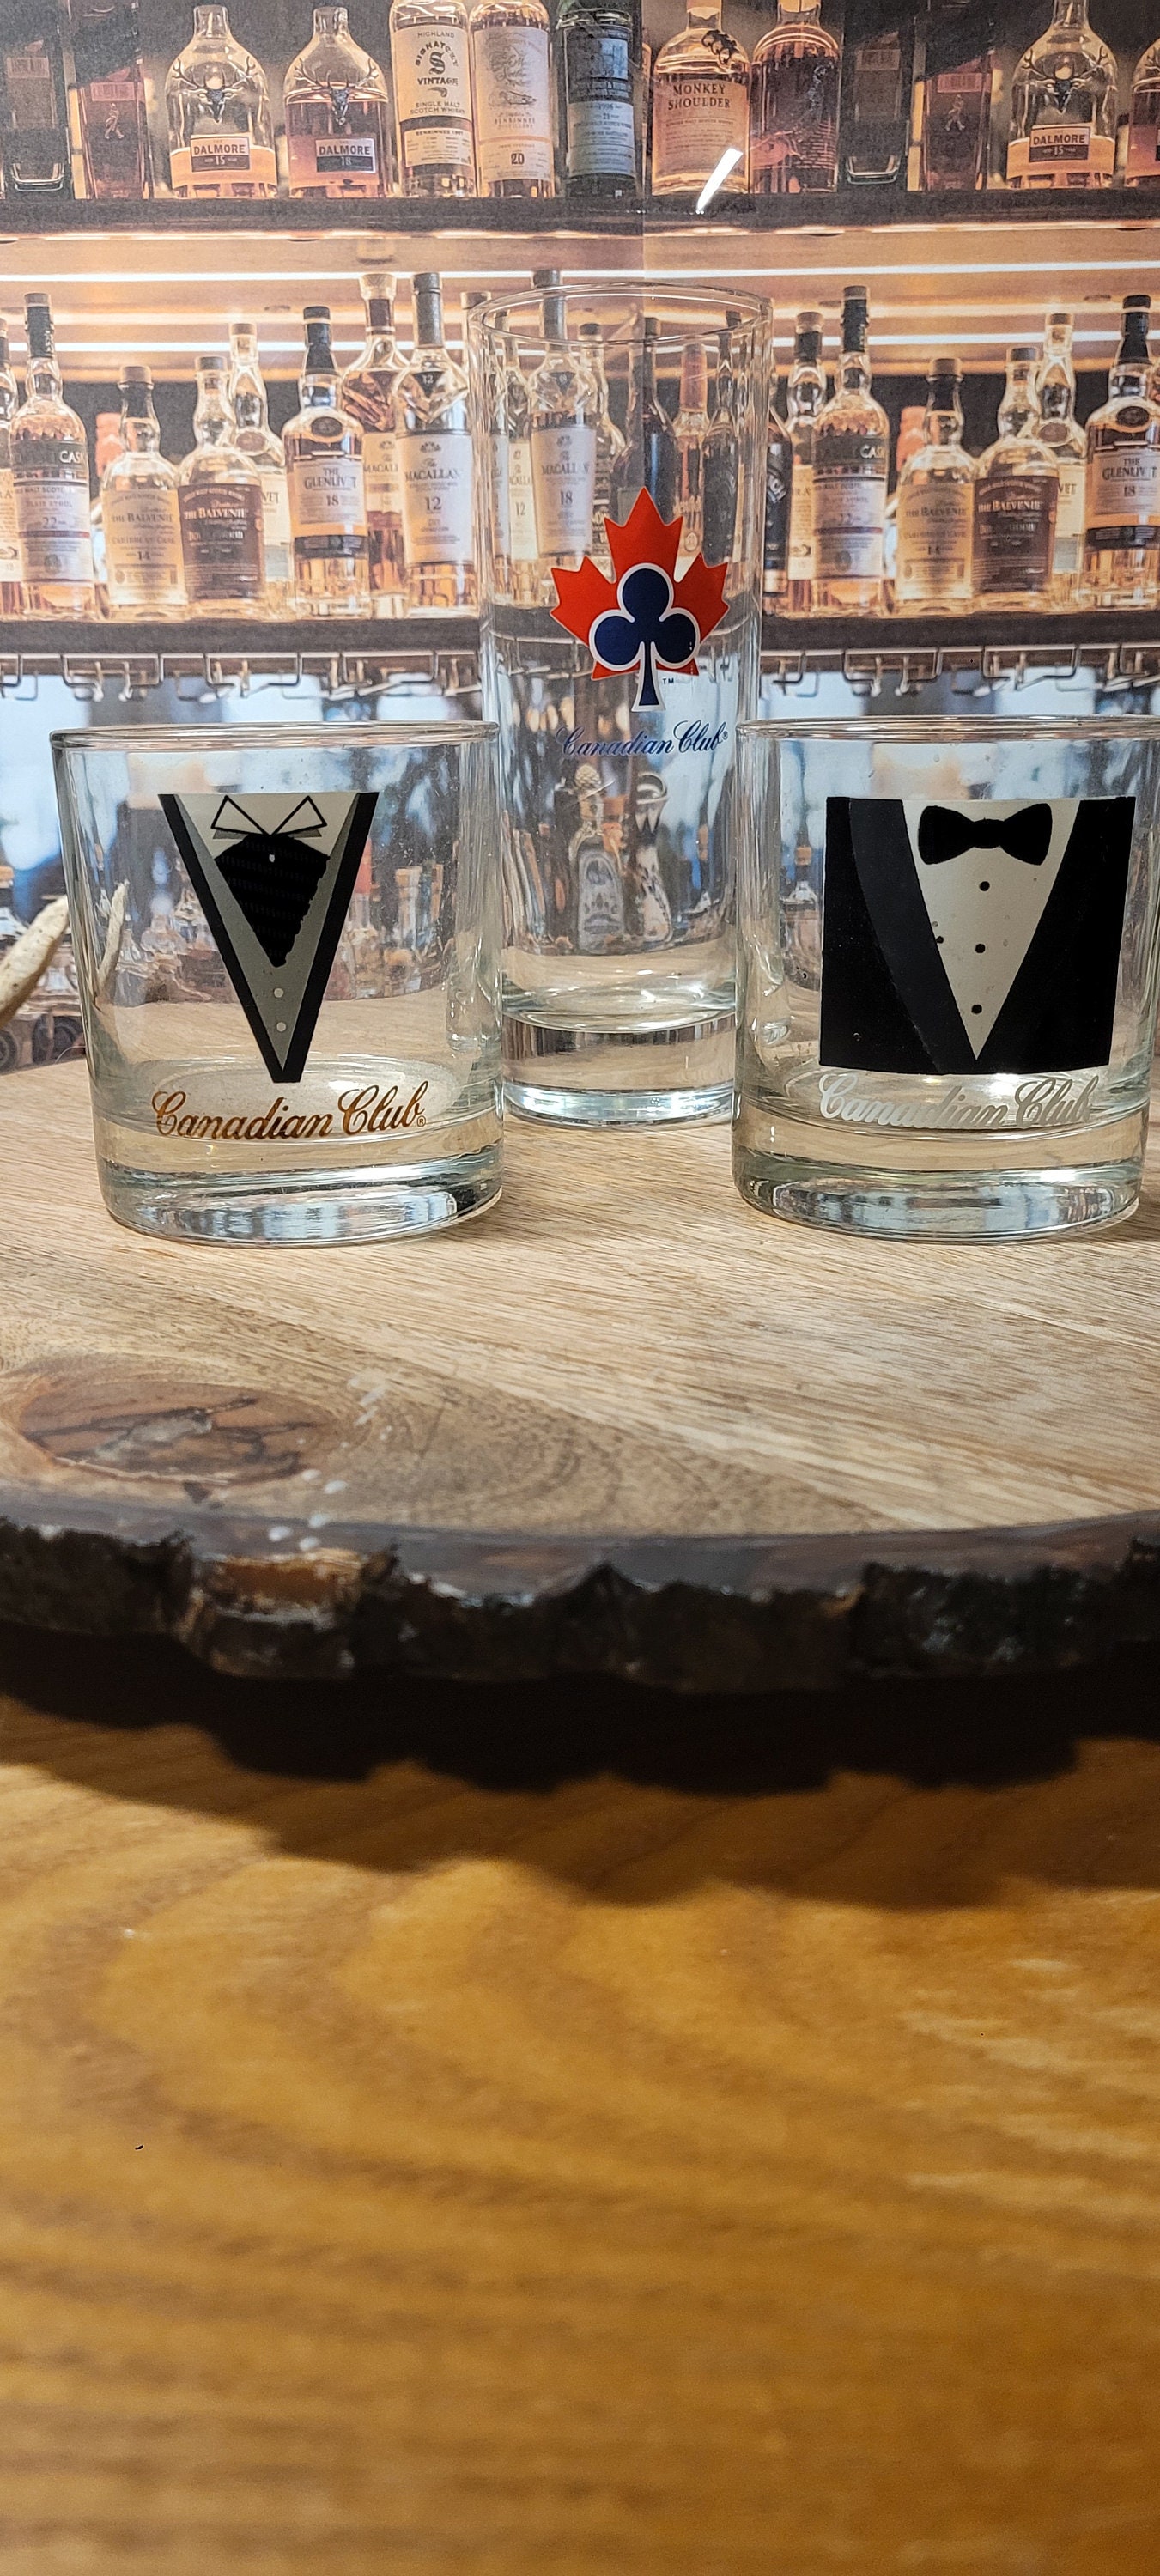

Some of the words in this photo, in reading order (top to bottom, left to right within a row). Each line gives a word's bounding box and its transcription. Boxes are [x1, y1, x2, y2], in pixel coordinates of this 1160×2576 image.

[417, 76, 459, 86] VINTAGE
[673, 82, 726, 95] MONKEY
[668, 97, 731, 110] SHOULDER
[1034, 133, 1085, 145] DALMORE
[193, 143, 246, 155] DALMORE
[319, 144, 371, 155] DALMORE
[1054, 146, 1064, 155] 15
[216, 155, 226, 165] 15
[511, 152, 525, 165] 20
[1102, 466, 1157, 481] GLENLIVT
[304, 476, 357, 490] GLENLIVT
[326, 495, 339, 507] 18
[425, 496, 442, 511] 12
[560, 490, 573, 506] 18
[556, 725, 674, 756] Canadian
[818, 1073, 1009, 1130] Canadian
[151, 1091, 334, 1140] Canadian
